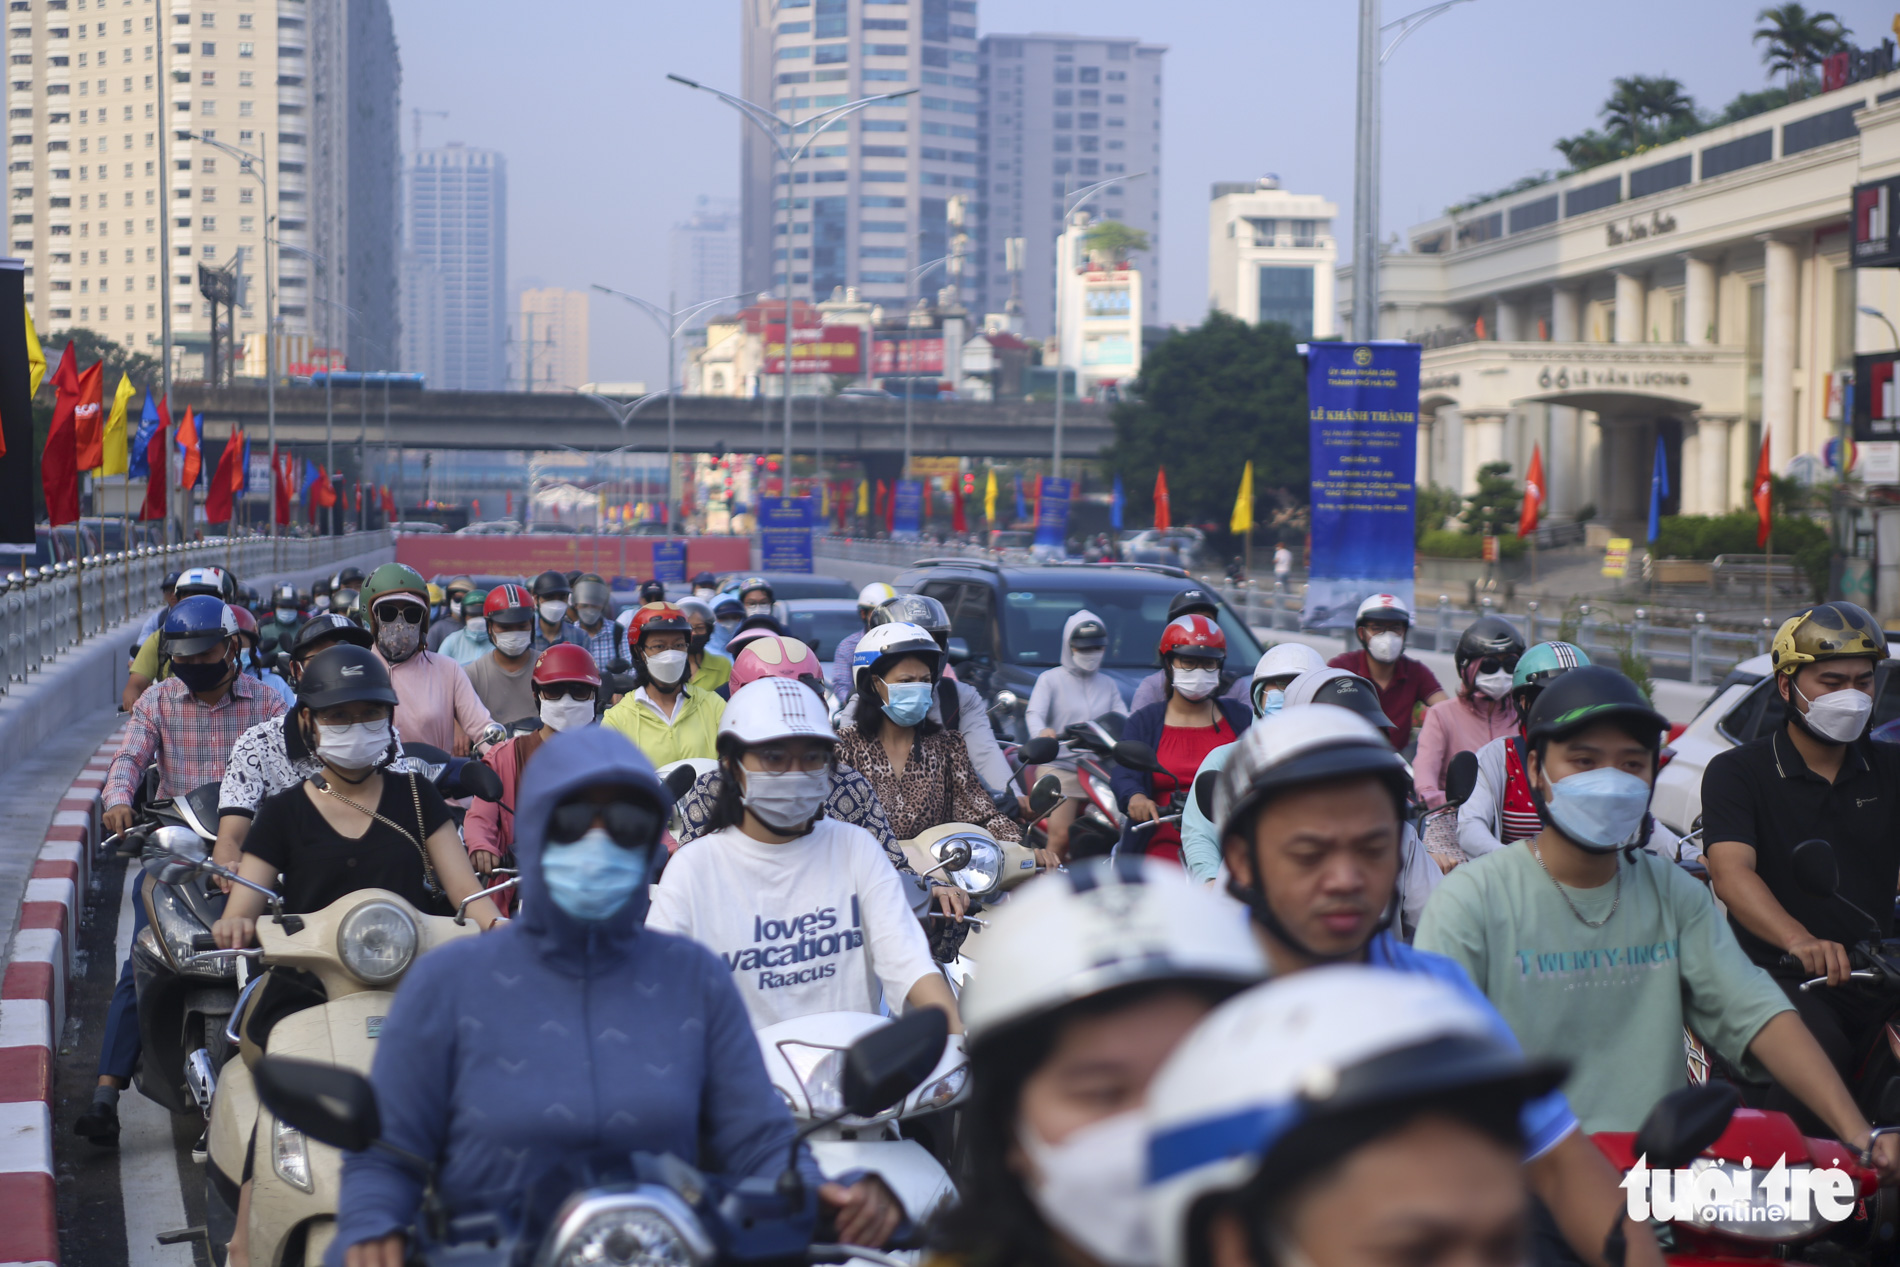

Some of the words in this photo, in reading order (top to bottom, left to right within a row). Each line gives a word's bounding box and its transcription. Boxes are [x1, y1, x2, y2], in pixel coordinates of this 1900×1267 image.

[1340, 368, 1356, 376] BAN
[1538, 365, 1569, 389] 66
[1594, 368, 1628, 384] VĂN
[1310, 406, 1324, 420] LỄ
[1326, 408, 1368, 420] KHÁNH
[1371, 409, 1414, 422] THÀNH
[754, 906, 837, 942] love's
[758, 962, 836, 990] Raacus
